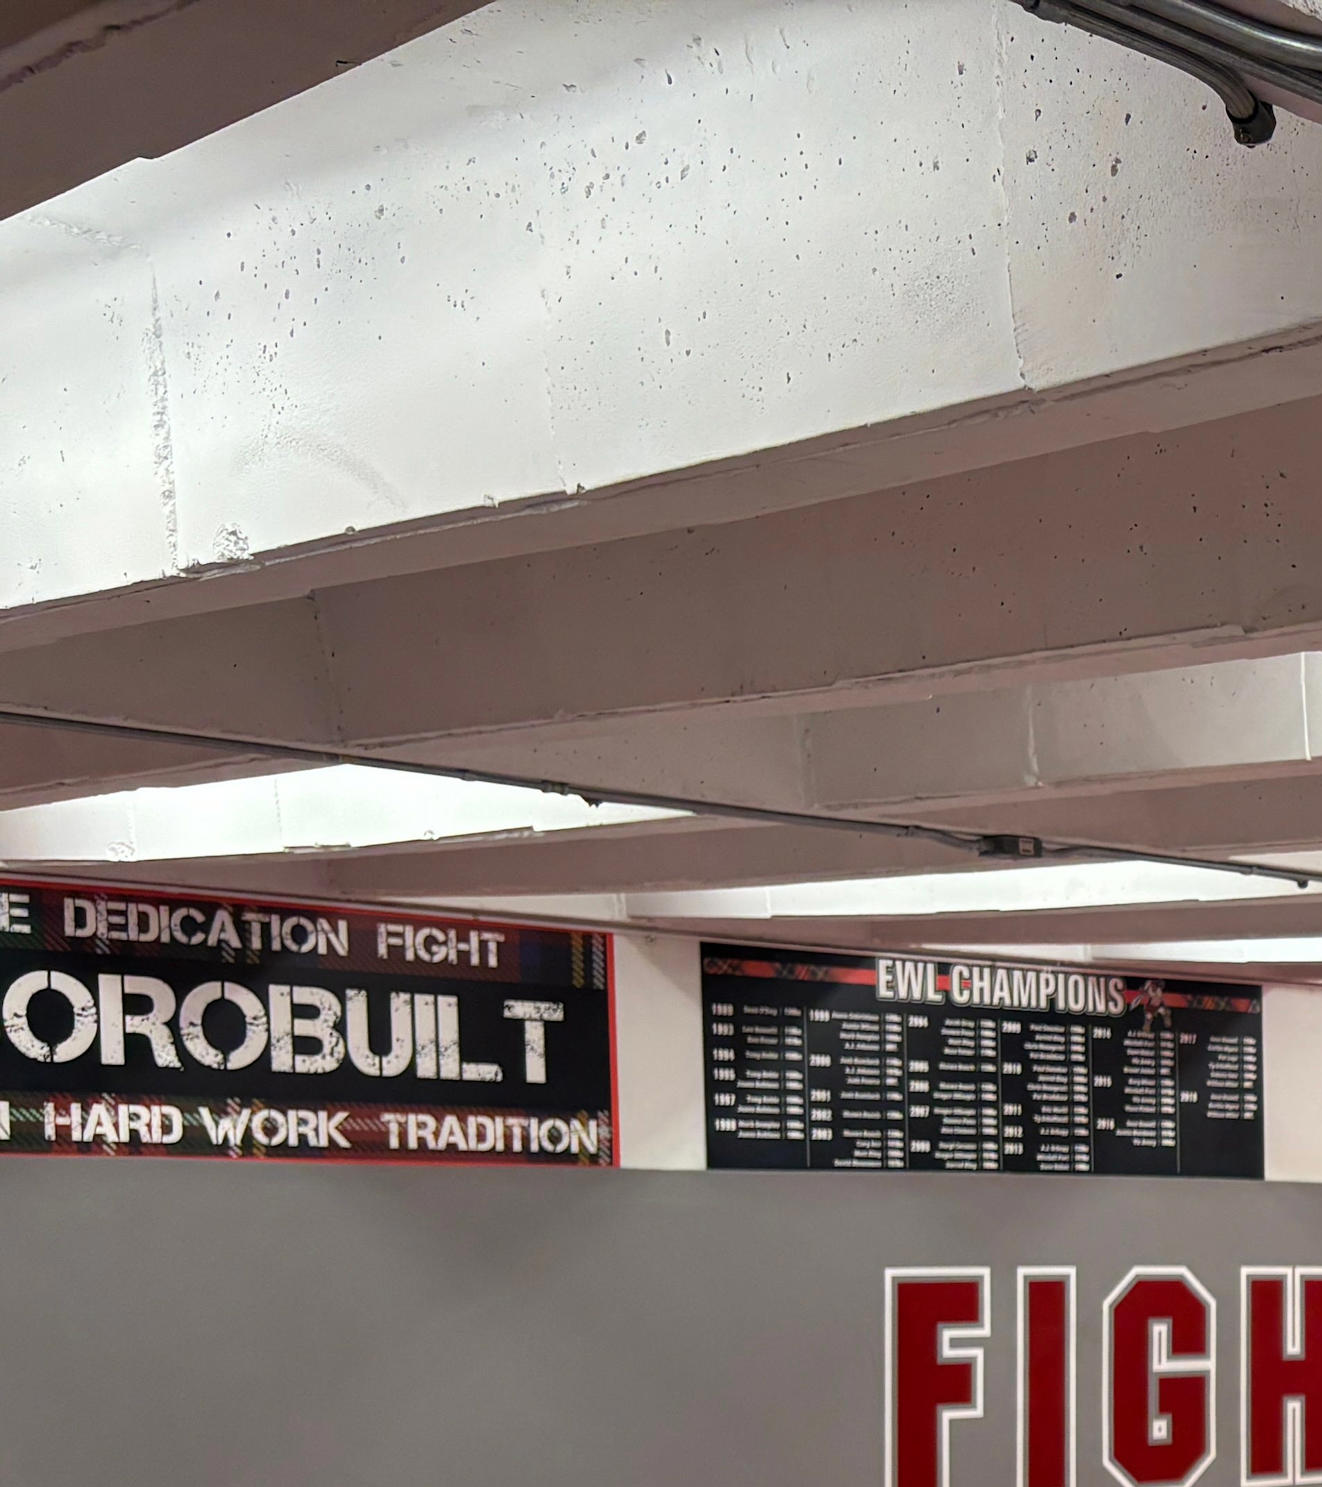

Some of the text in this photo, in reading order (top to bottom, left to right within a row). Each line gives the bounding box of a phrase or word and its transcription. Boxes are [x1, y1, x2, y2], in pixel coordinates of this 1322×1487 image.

[63, 896, 349, 957] DEDICATION
[377, 922, 505, 968] FIGHT
[877, 957, 1125, 1017] EWL CHAMPIONS
[2, 970, 565, 1085] OROBUILT
[44, 1101, 185, 1145] HARD
[198, 1106, 352, 1148] WORK
[381, 1112, 599, 1155] TRADITION
